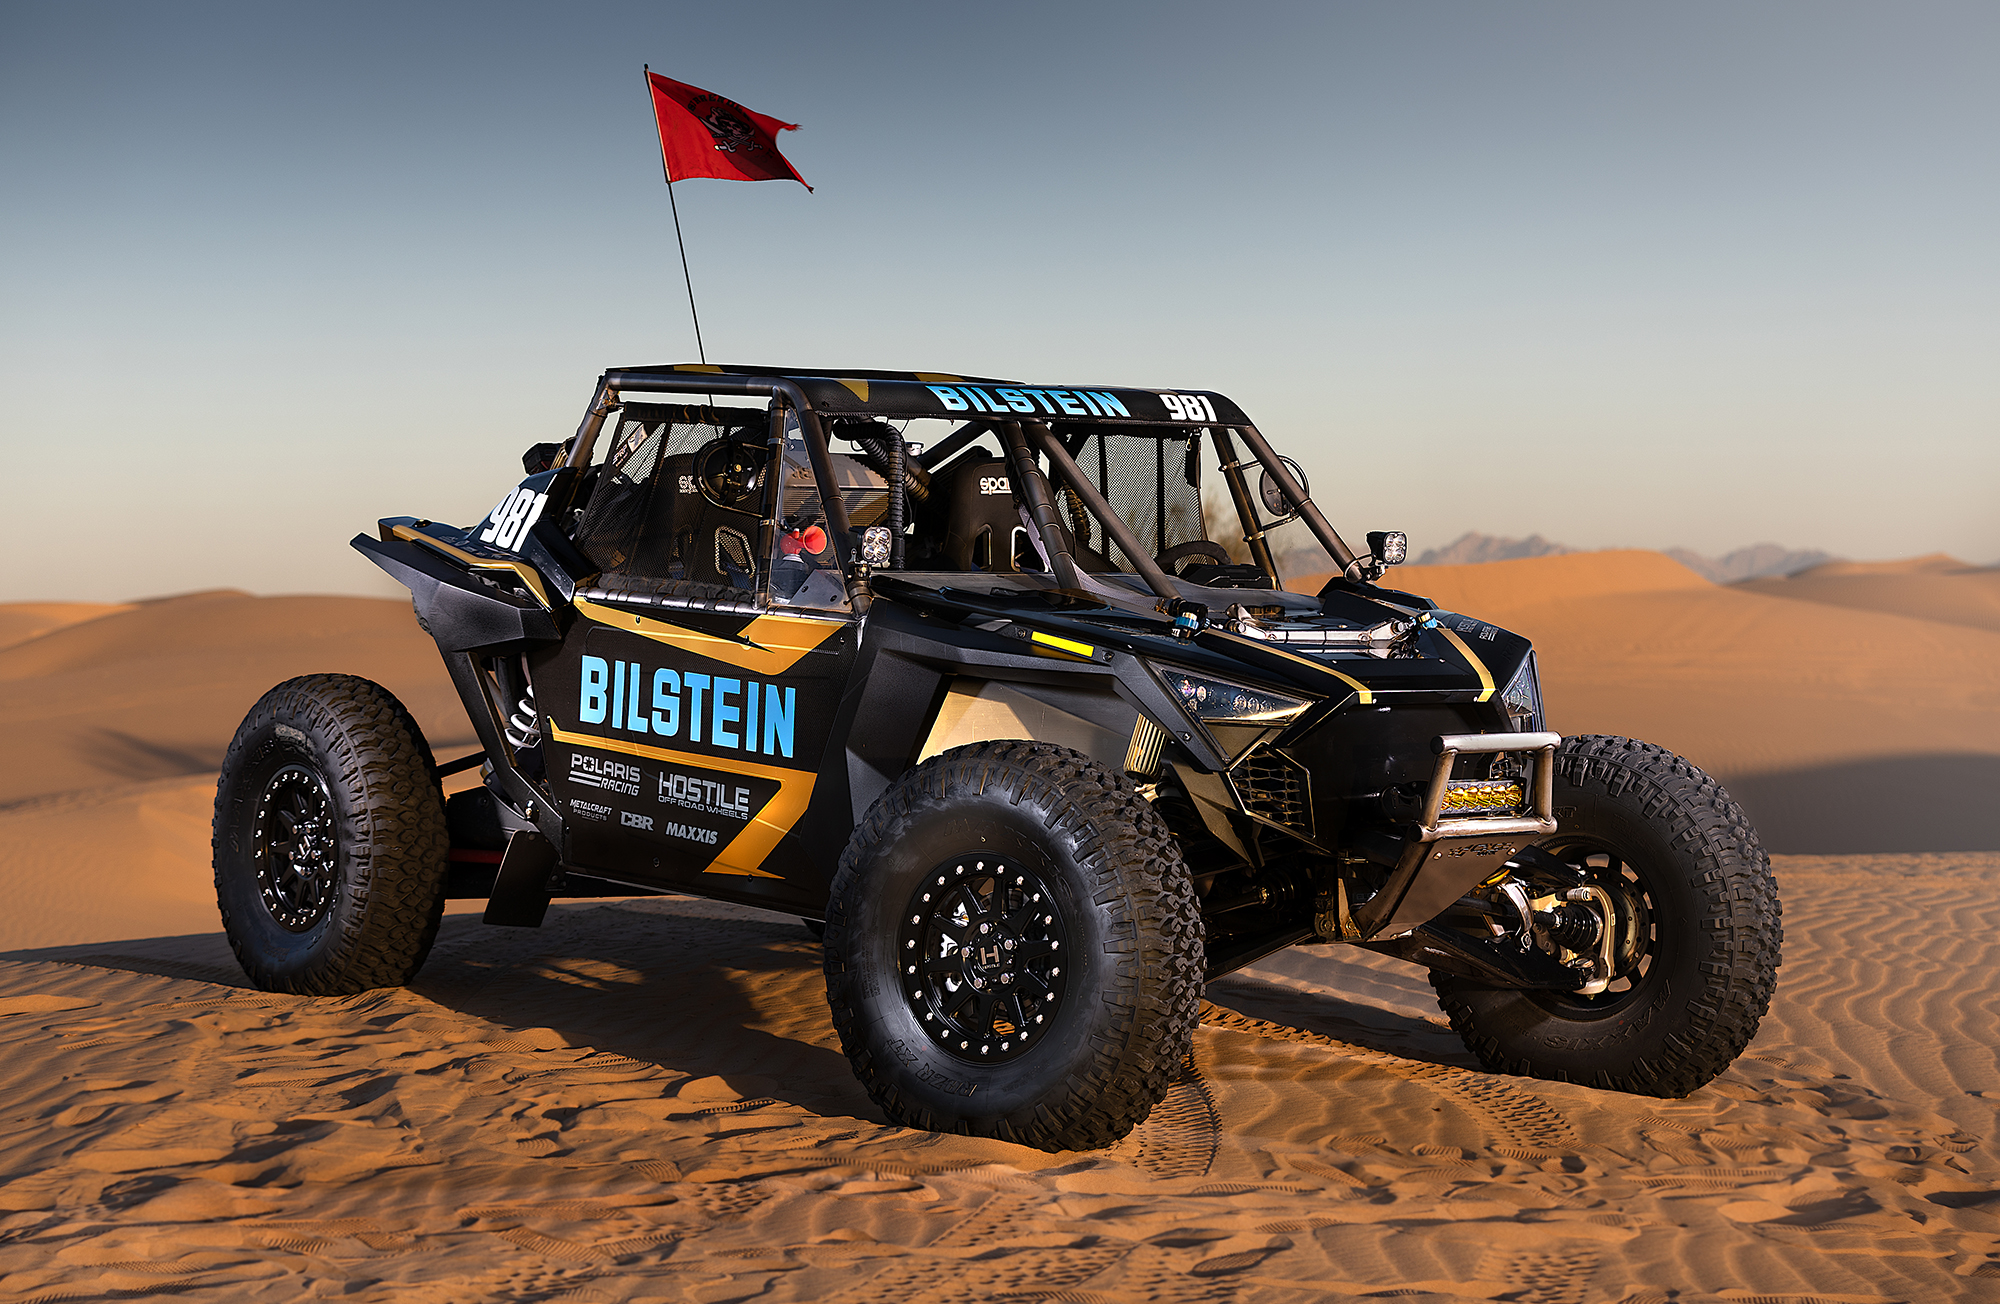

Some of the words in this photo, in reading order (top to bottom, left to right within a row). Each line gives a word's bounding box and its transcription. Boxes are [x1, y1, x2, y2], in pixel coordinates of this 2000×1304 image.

[926, 385, 1132, 417] BILSTEIN
[1157, 393, 1218, 421] 981
[479, 485, 549, 553] 981
[579, 655, 796, 758] BILSTEIN
[571, 753, 640, 782] POLARIS
[600, 778, 640, 796] RACING
[658, 771, 750, 812] HOSTILE
[569, 799, 612, 815] METALCRAFT
[573, 808, 608, 821] PRODUCTS
[620, 811, 654, 831] CBR
[658, 796, 677, 804] OFF
[678, 799, 705, 811] ROAD
[706, 805, 748, 820] WHEELS
[665, 821, 719, 845] MAXXIS
[1543, 978, 1672, 1051] MAXXIS
[887, 1037, 919, 1067] XT
[915, 1062, 978, 1098] RAZR
